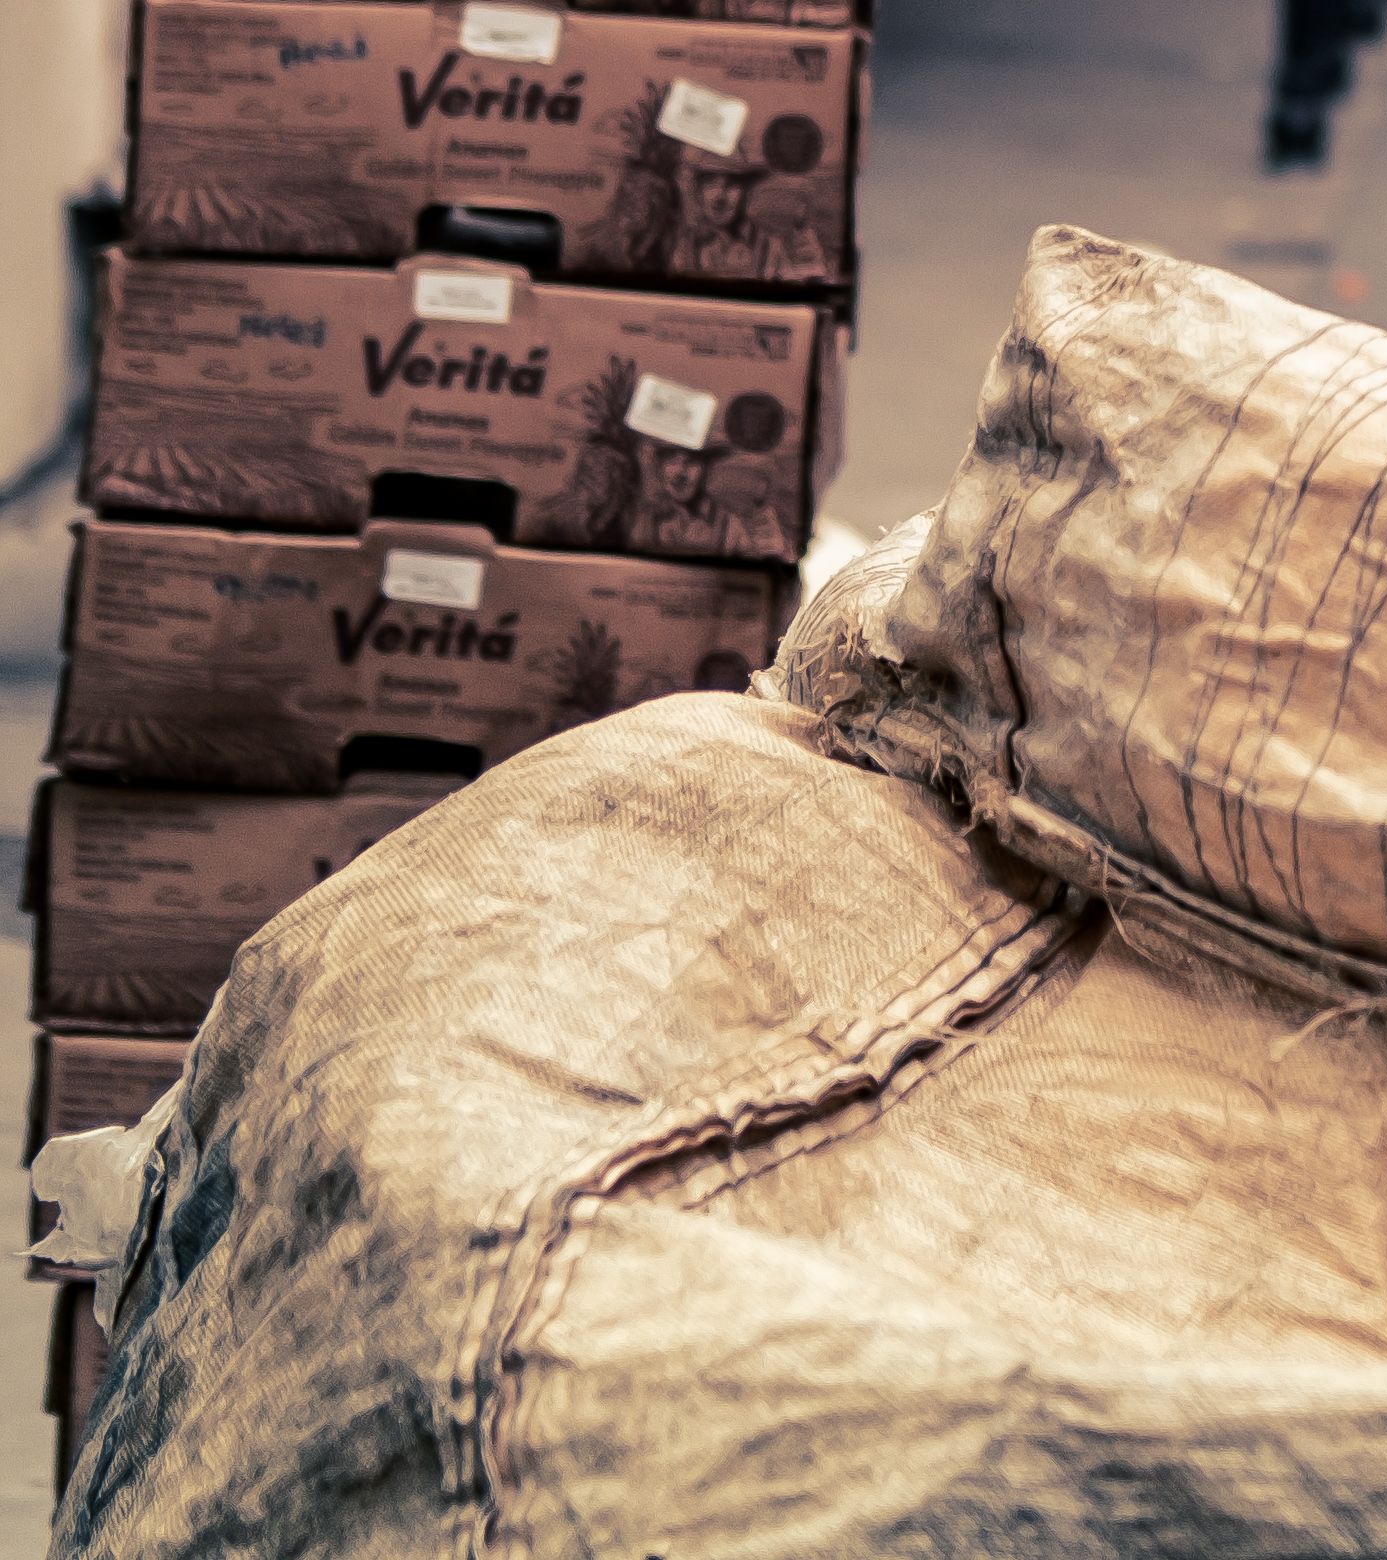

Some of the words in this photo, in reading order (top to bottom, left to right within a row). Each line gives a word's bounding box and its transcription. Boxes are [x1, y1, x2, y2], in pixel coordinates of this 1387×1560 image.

[398, 50, 587, 129] Veritá
[363, 320, 549, 398] Veritá
[333, 595, 521, 667] Veritá
